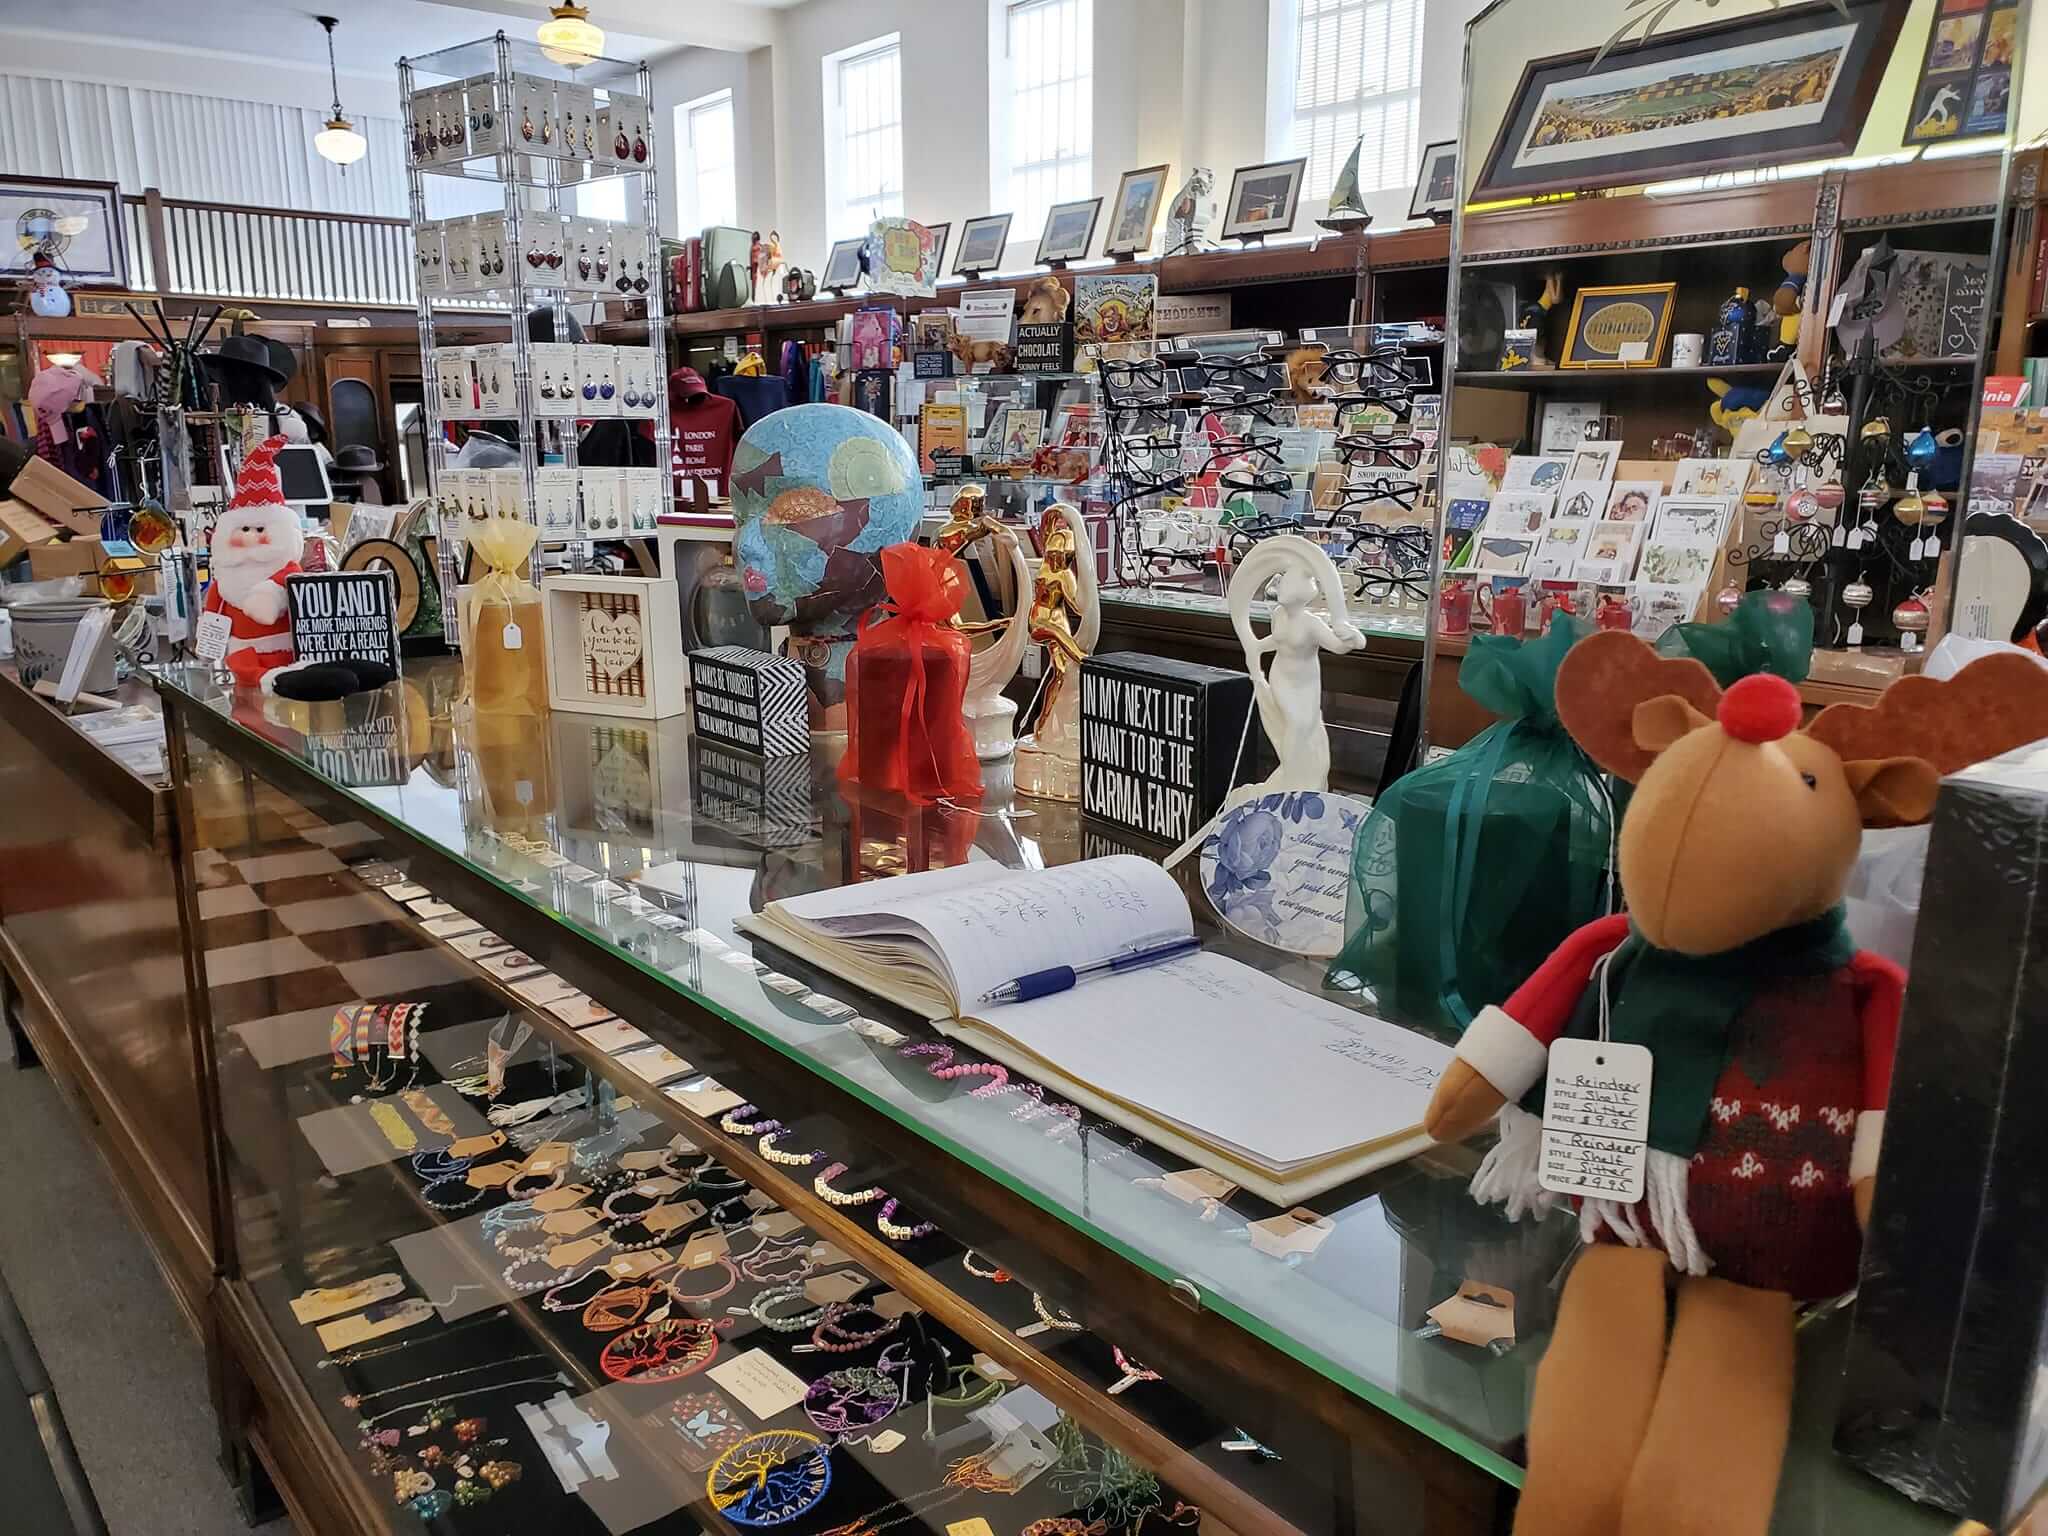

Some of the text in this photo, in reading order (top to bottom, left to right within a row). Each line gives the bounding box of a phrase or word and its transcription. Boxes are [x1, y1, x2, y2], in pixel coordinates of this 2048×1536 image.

[1157, 306, 1221, 320] THOUGHTS
[1019, 325, 1060, 338] ACTUALLY
[1018, 343, 1060, 357] CHOCOLATE
[684, 431, 716, 440] LONDON
[291, 580, 386, 618] YOU AND I
[296, 615, 388, 634] ARE MORE THAN FRIENDS
[296, 631, 389, 653] WE'RE LIKE A REALLY
[695, 662, 754, 698] ALWAYS BE YOURSELF
[738, 702, 758, 722] UNICORN
[1083, 673, 1195, 741] IN MY NEXT LIFE
[698, 712, 709, 731] THEN
[710, 715, 728, 737] ALWAYS
[738, 724, 760, 746] UNICORN
[1083, 719, 1194, 788] I WANT TO BE THE
[1084, 762, 1194, 843] KARMA FAIRY
[1289, 832, 1336, 859] Always
[1286, 882, 1344, 899] just like
[1278, 899, 1324, 921] everyone
[1576, 1075, 1640, 1093] Reindeer
[1553, 1102, 1570, 1110] SIZE
[1554, 1089, 1630, 1105] STYLE Shelf
[1552, 1114, 1575, 1123] PRICE
[1571, 1134, 1642, 1154] Reindeer
[1547, 1162, 1565, 1170] SIZE
[1549, 1149, 1624, 1166] STYLE Shelf
[1546, 1174, 1571, 1184] PRICE
